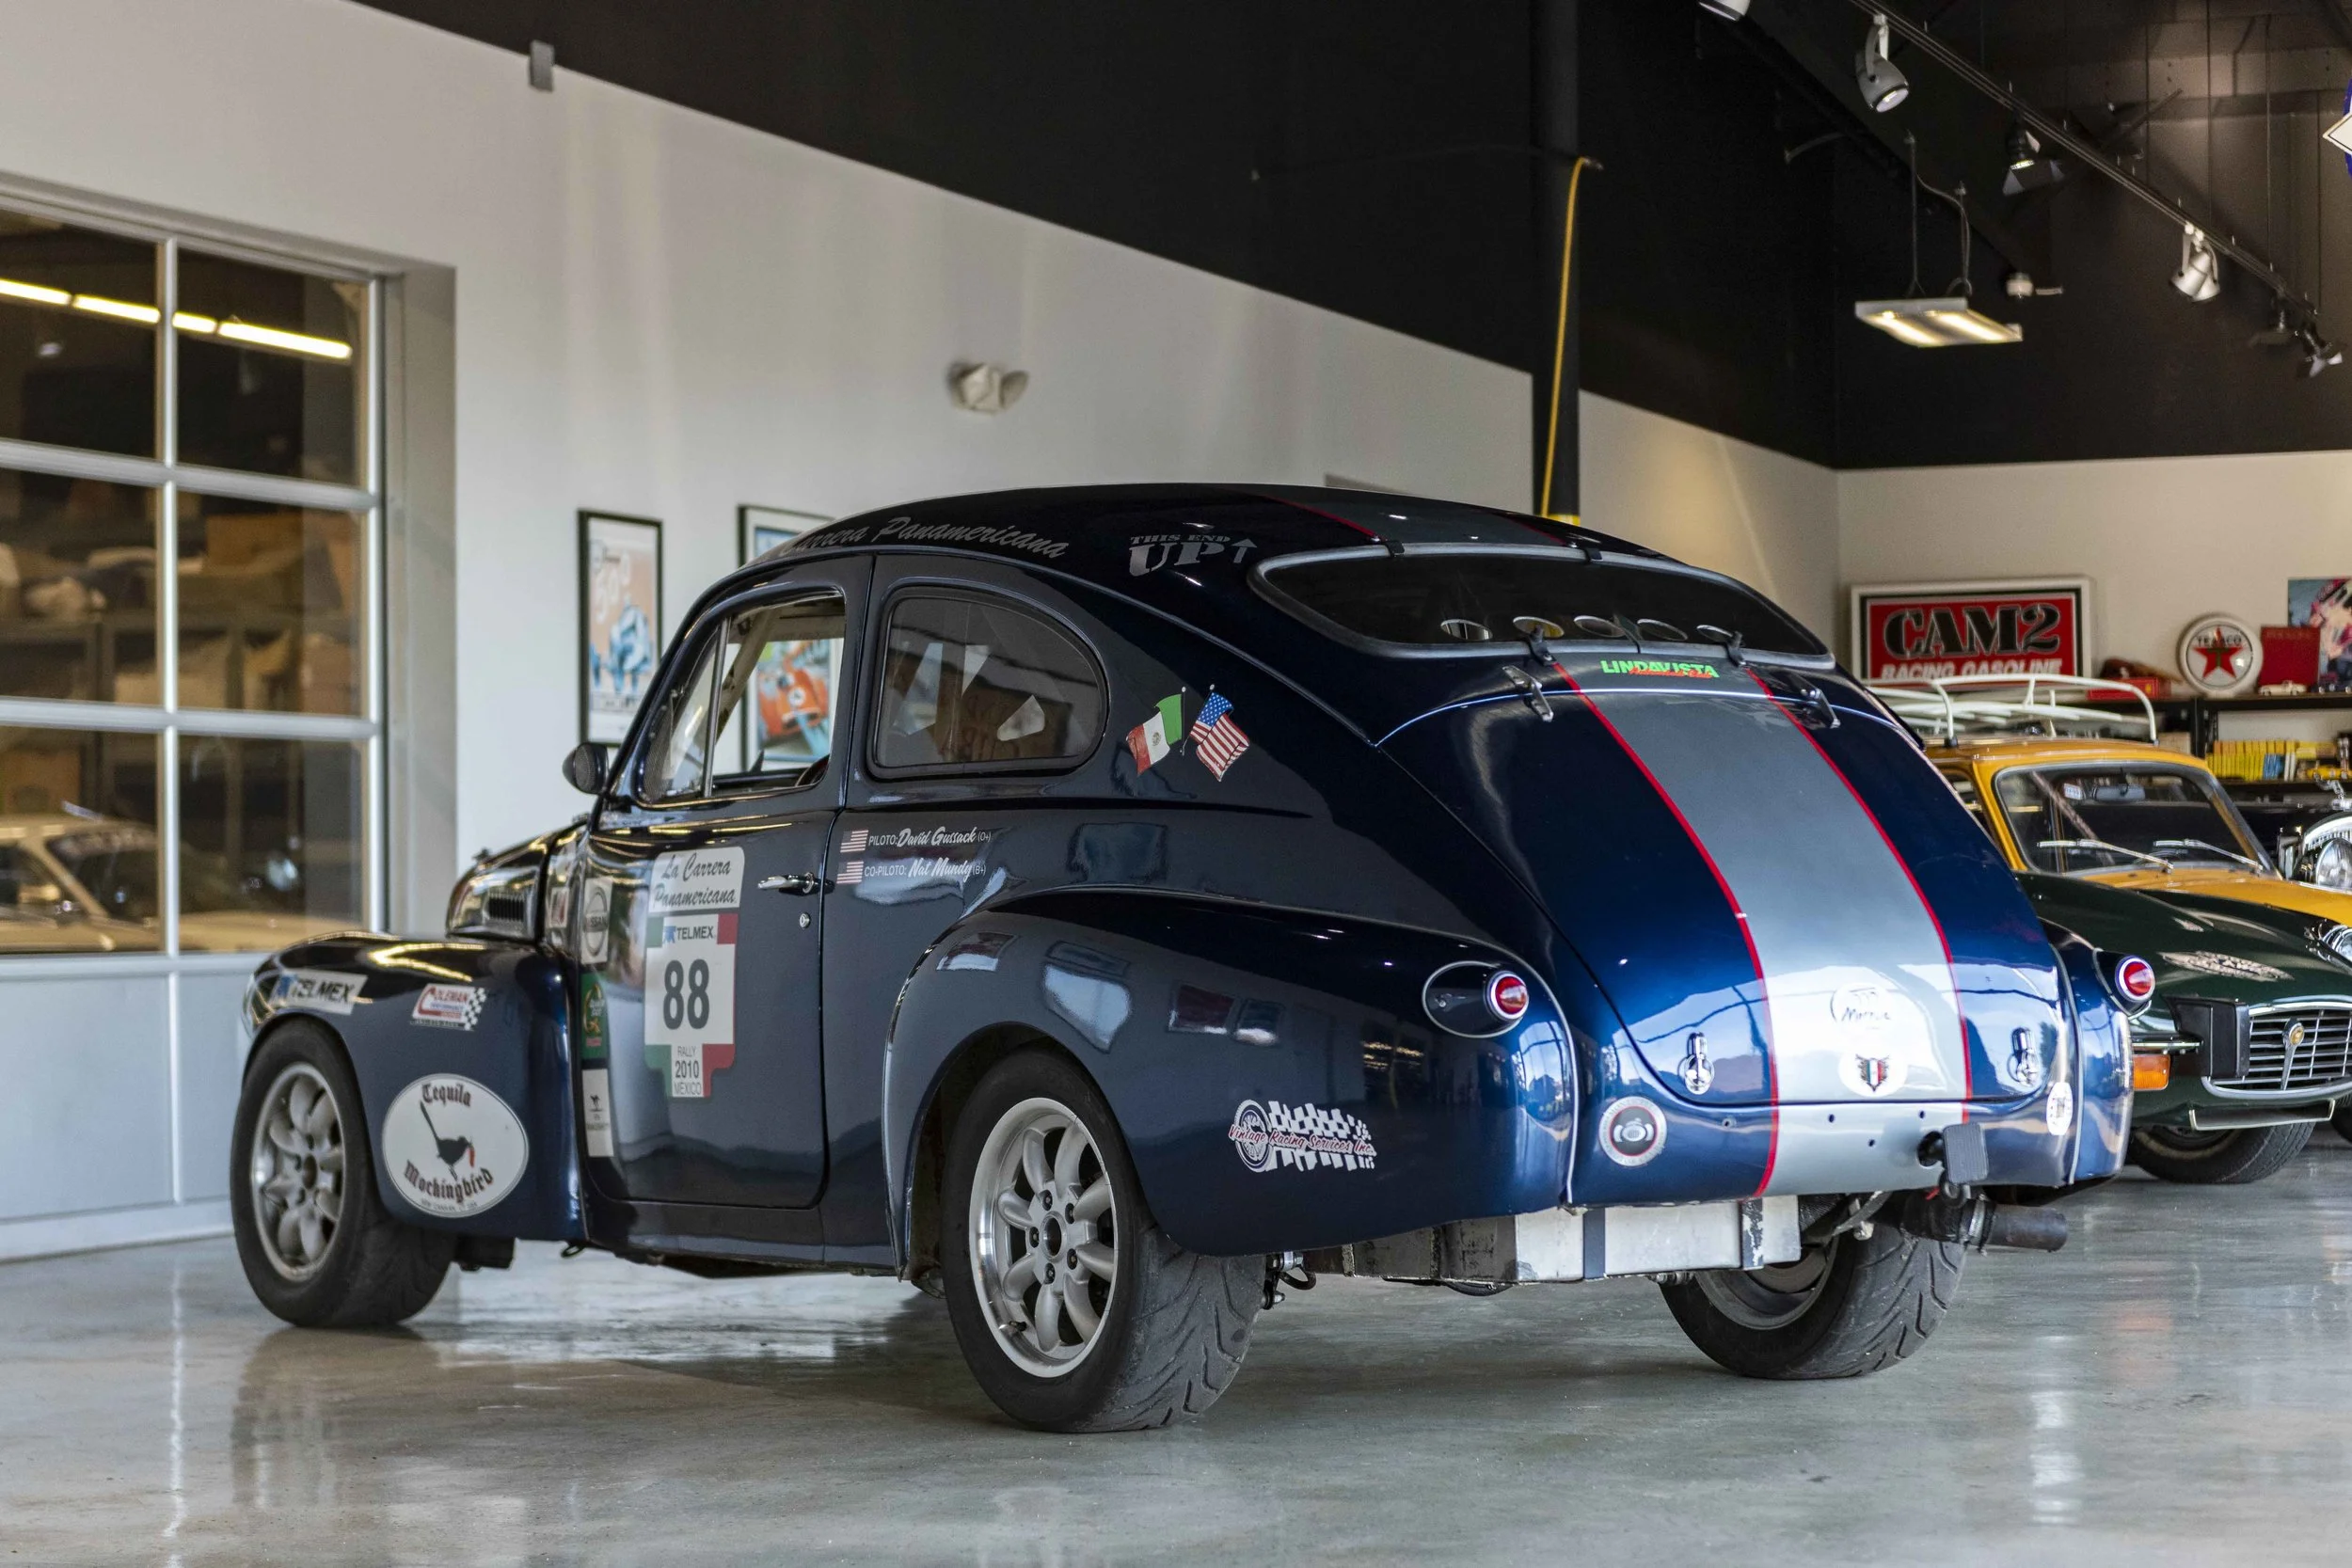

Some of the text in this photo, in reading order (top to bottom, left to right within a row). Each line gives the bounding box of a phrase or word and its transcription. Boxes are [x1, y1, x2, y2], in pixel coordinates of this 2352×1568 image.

[871, 516, 1070, 558] Panamericana
[1130, 534, 1231, 545] THIS END
[1129, 542, 1225, 577] UP
[1883, 603, 2060, 659] CAM2
[1600, 660, 1720, 678] LINDAVISTA
[1881, 658, 2063, 681] RACING GASOLINE
[868, 834, 898, 846] PILOTO:
[897, 828, 931, 847] David
[930, 826, 977, 846] Gussack
[660, 852, 731, 882] La Carrera
[864, 864, 907, 877] CO-PILOTO:
[907, 857, 931, 878] Nat
[930, 857, 973, 882] Mundy
[652, 882, 736, 909] Panamericana
[676, 926, 714, 941] TELMEX
[289, 977, 357, 1003] TELMEX
[662, 958, 709, 1030] 88
[677, 1046, 696, 1057] RALLY
[675, 1060, 700, 1079] 2010
[421, 1083, 471, 1108] Tequila
[1228, 1124, 1376, 1156] Vintage Racing Services Inc.
[404, 1159, 494, 1204] Mockingbird
